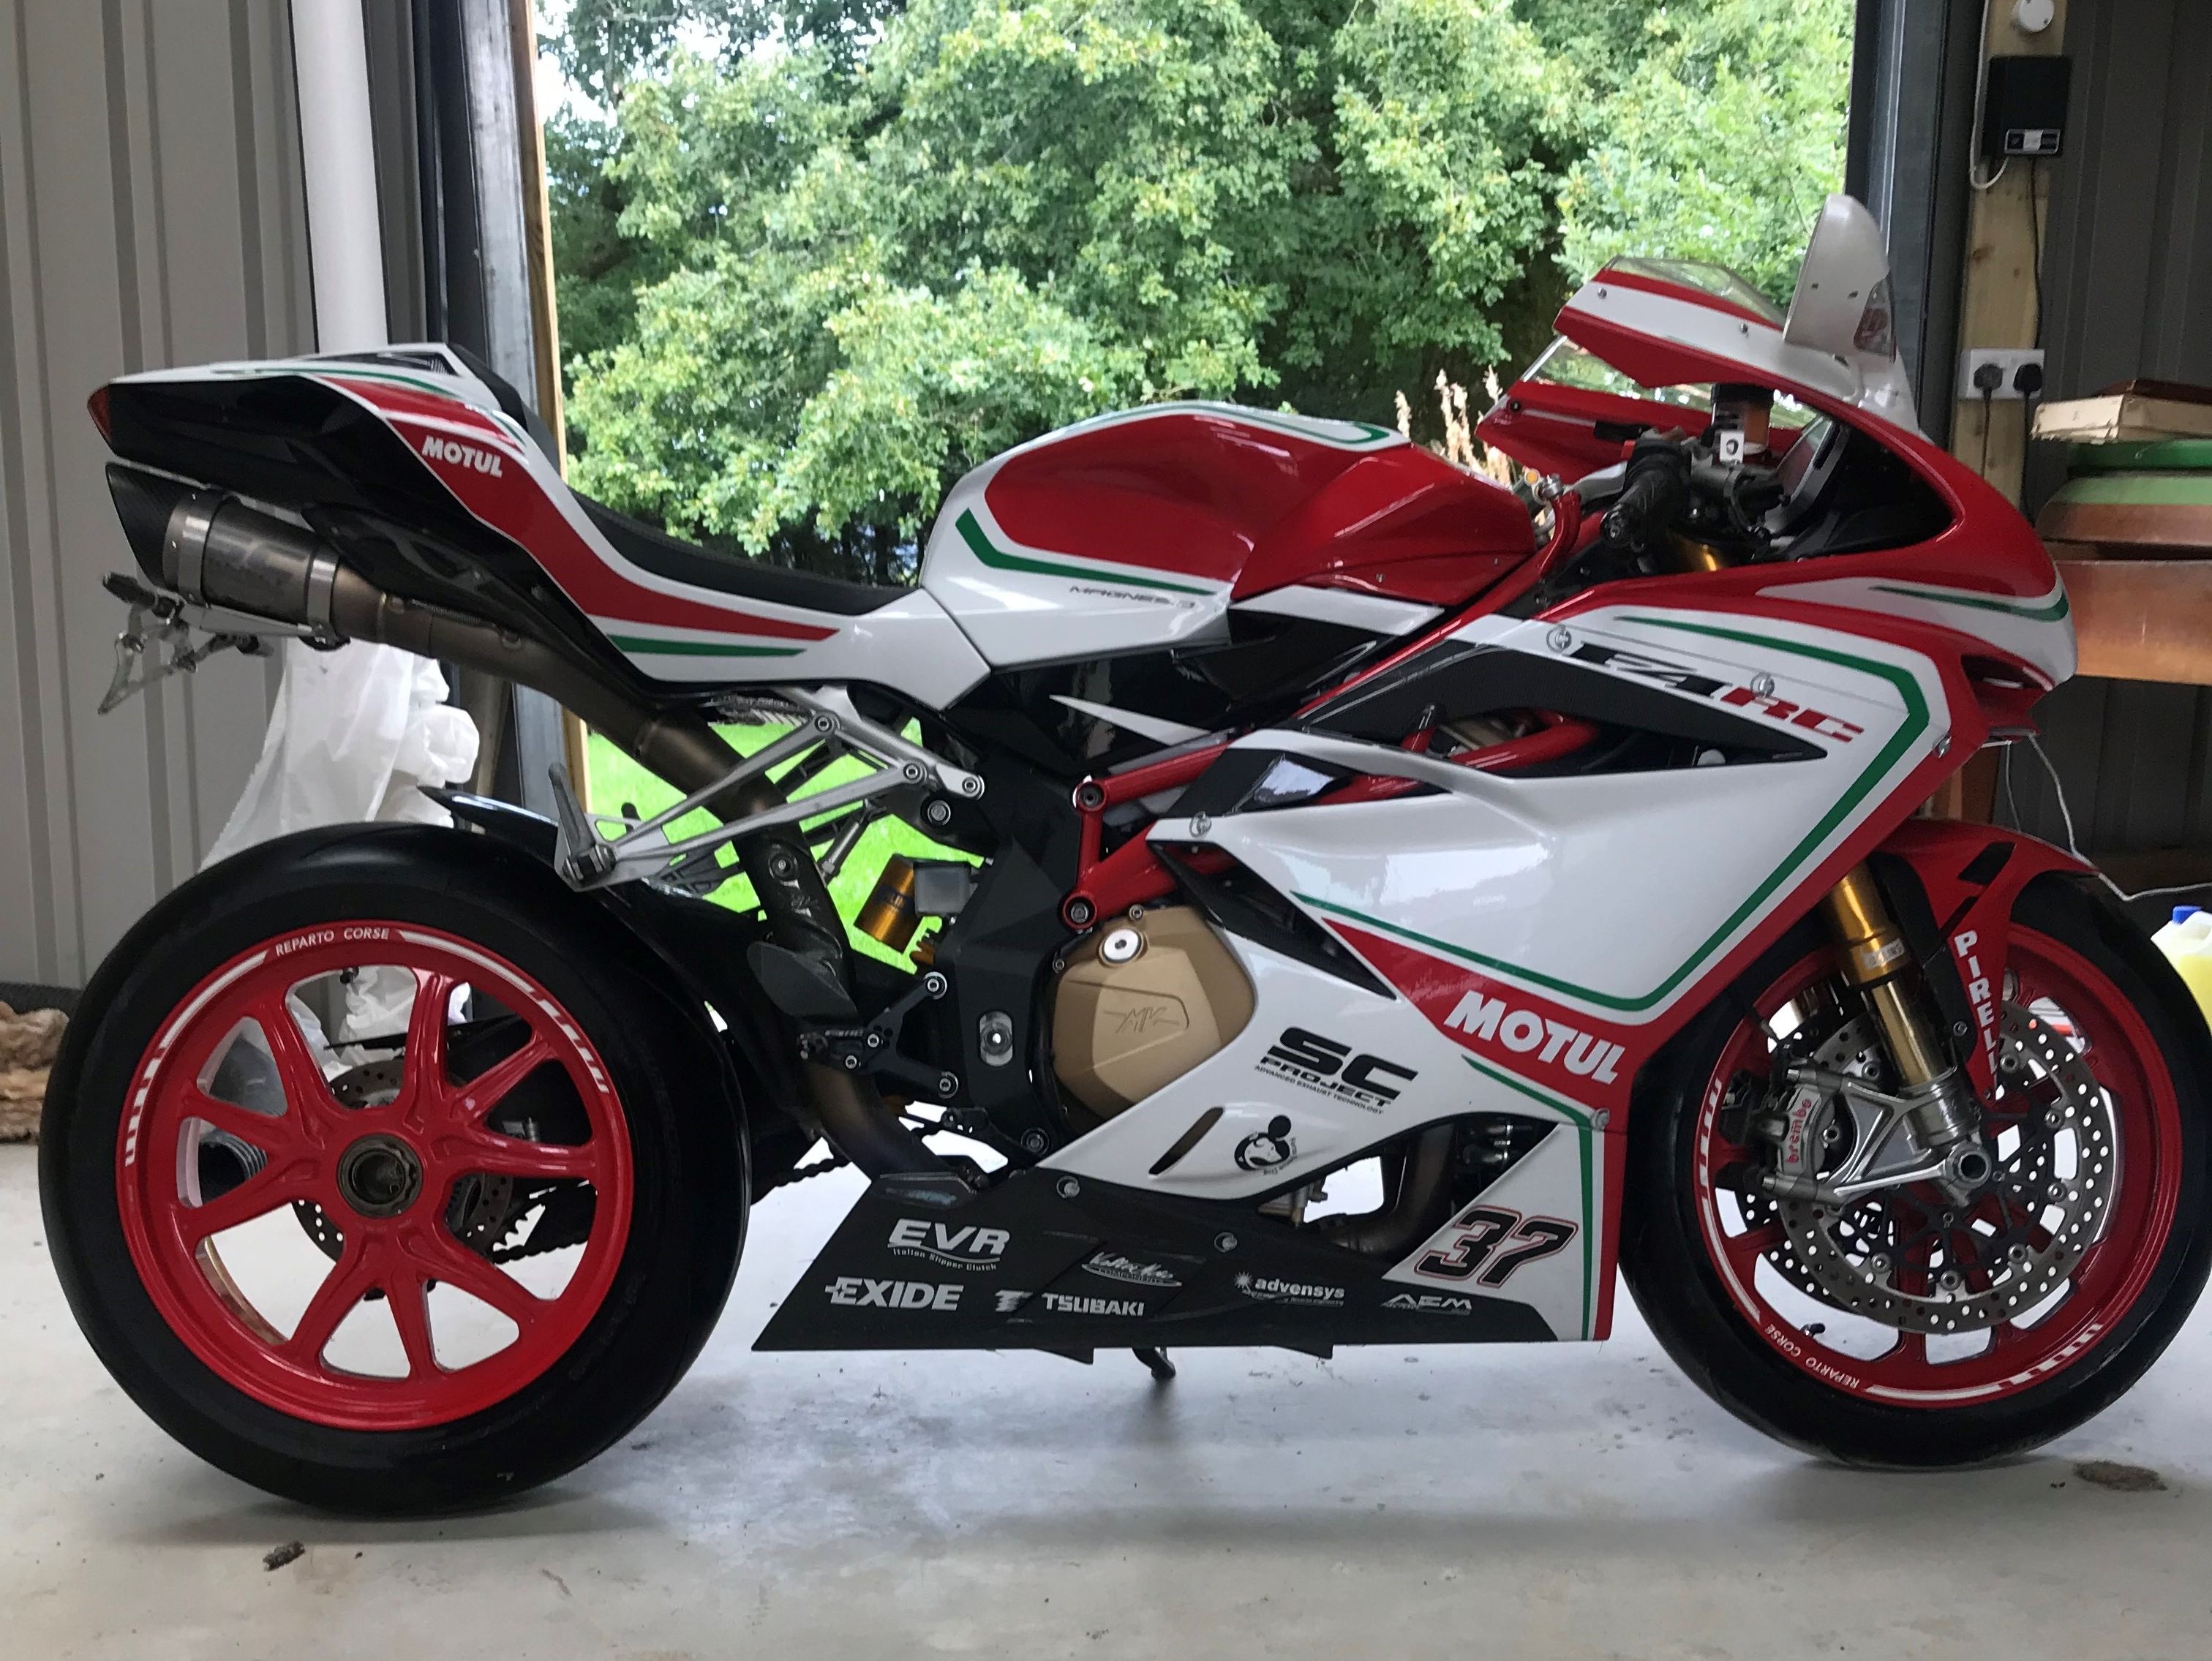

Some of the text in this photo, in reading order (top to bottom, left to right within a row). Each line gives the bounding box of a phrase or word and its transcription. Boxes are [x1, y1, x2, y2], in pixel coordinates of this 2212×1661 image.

[422, 434, 503, 478] MOTUL
[275, 927, 389, 957] REPARTO CORSE
[1267, 1026, 1418, 1100] SC
[1443, 990, 1625, 1085] MOTUL
[1254, 1064, 1384, 1115] ADVANCED EXHAUST TECHNOLOGY
[1260, 1056, 1391, 1107] PROJECT
[1786, 1098, 1812, 1164] brembo
[889, 1218, 1010, 1255] EVR
[1414, 1205, 1579, 1289] 37
[827, 1276, 964, 1311] EXIDE
[1041, 1292, 1145, 1316] TSUBAKI
[1255, 1278, 1344, 1300] advensys
[1764, 1324, 1860, 1389] REPARTO CORSE
